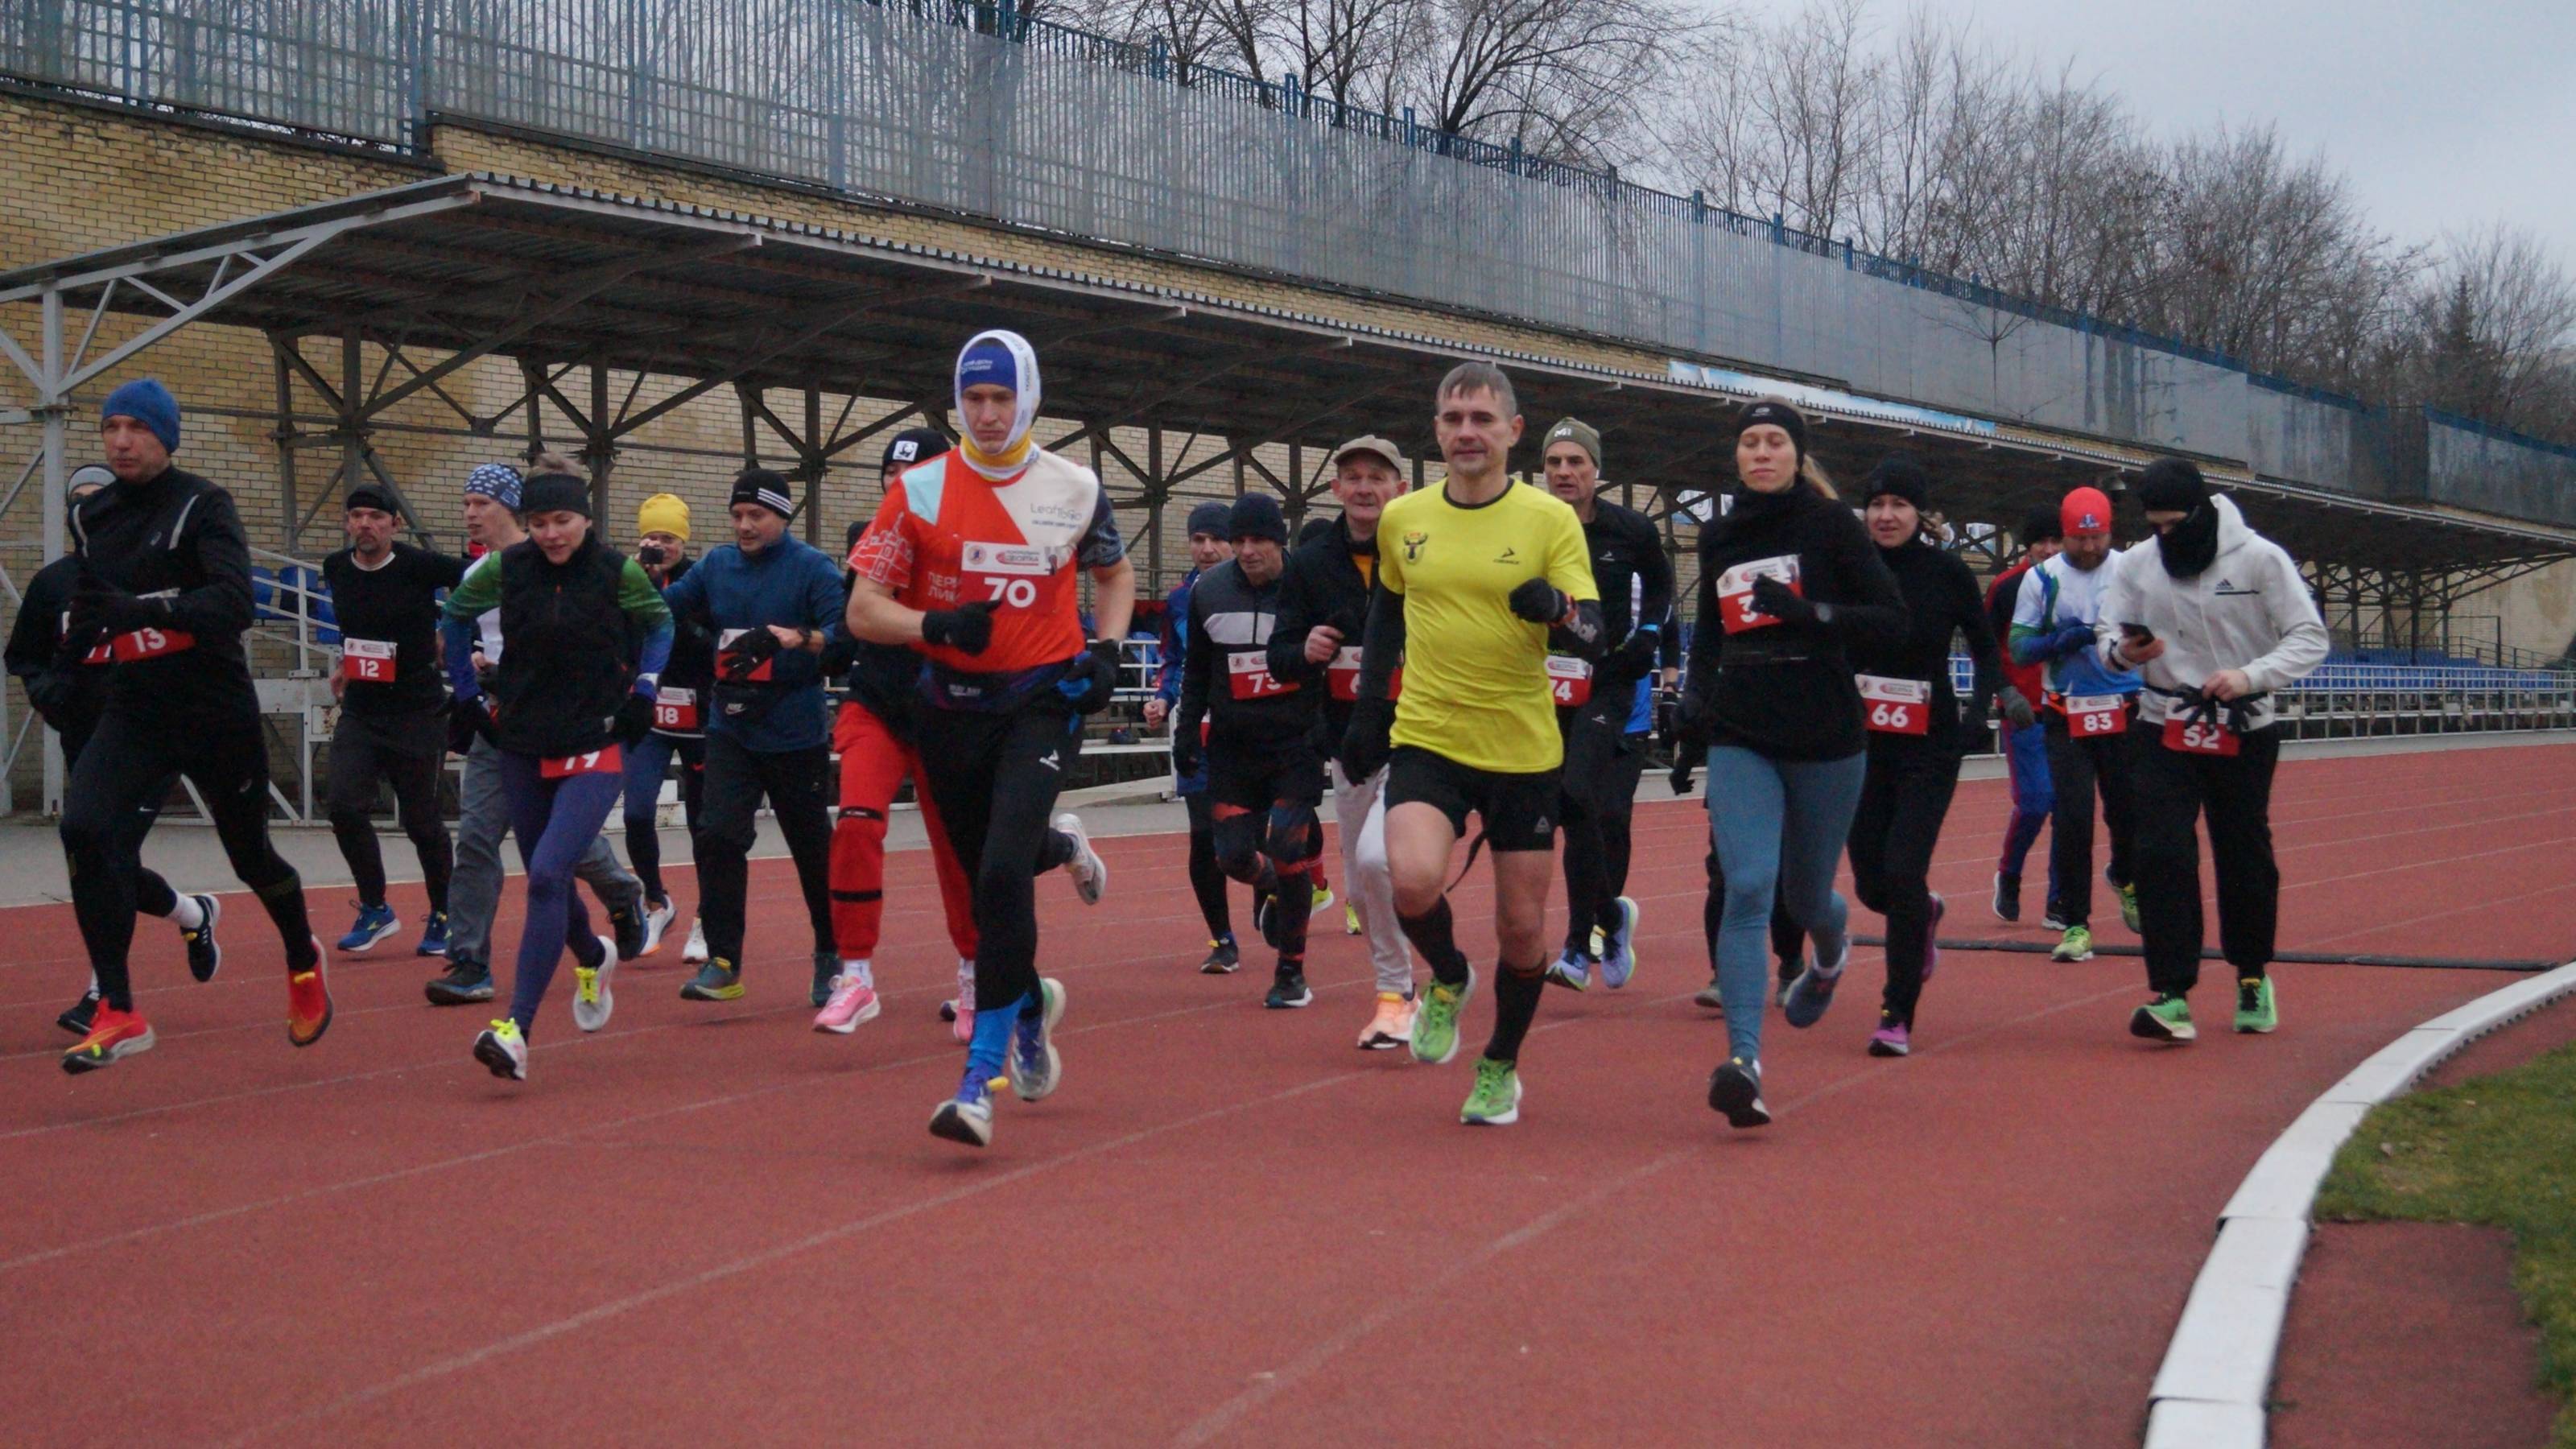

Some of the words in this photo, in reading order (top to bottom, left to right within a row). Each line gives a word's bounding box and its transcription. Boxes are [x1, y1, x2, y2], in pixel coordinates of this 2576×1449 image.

[984, 576, 1036, 608] 70
[130, 627, 167, 653] 13
[359, 659, 379, 677] 12
[1249, 673, 1282, 693] 73
[1550, 679, 1572, 701] 74
[656, 706, 679, 724] 18
[1872, 704, 1909, 728] 66
[2083, 712, 2113, 732] 83
[2183, 725, 2220, 749] 52
